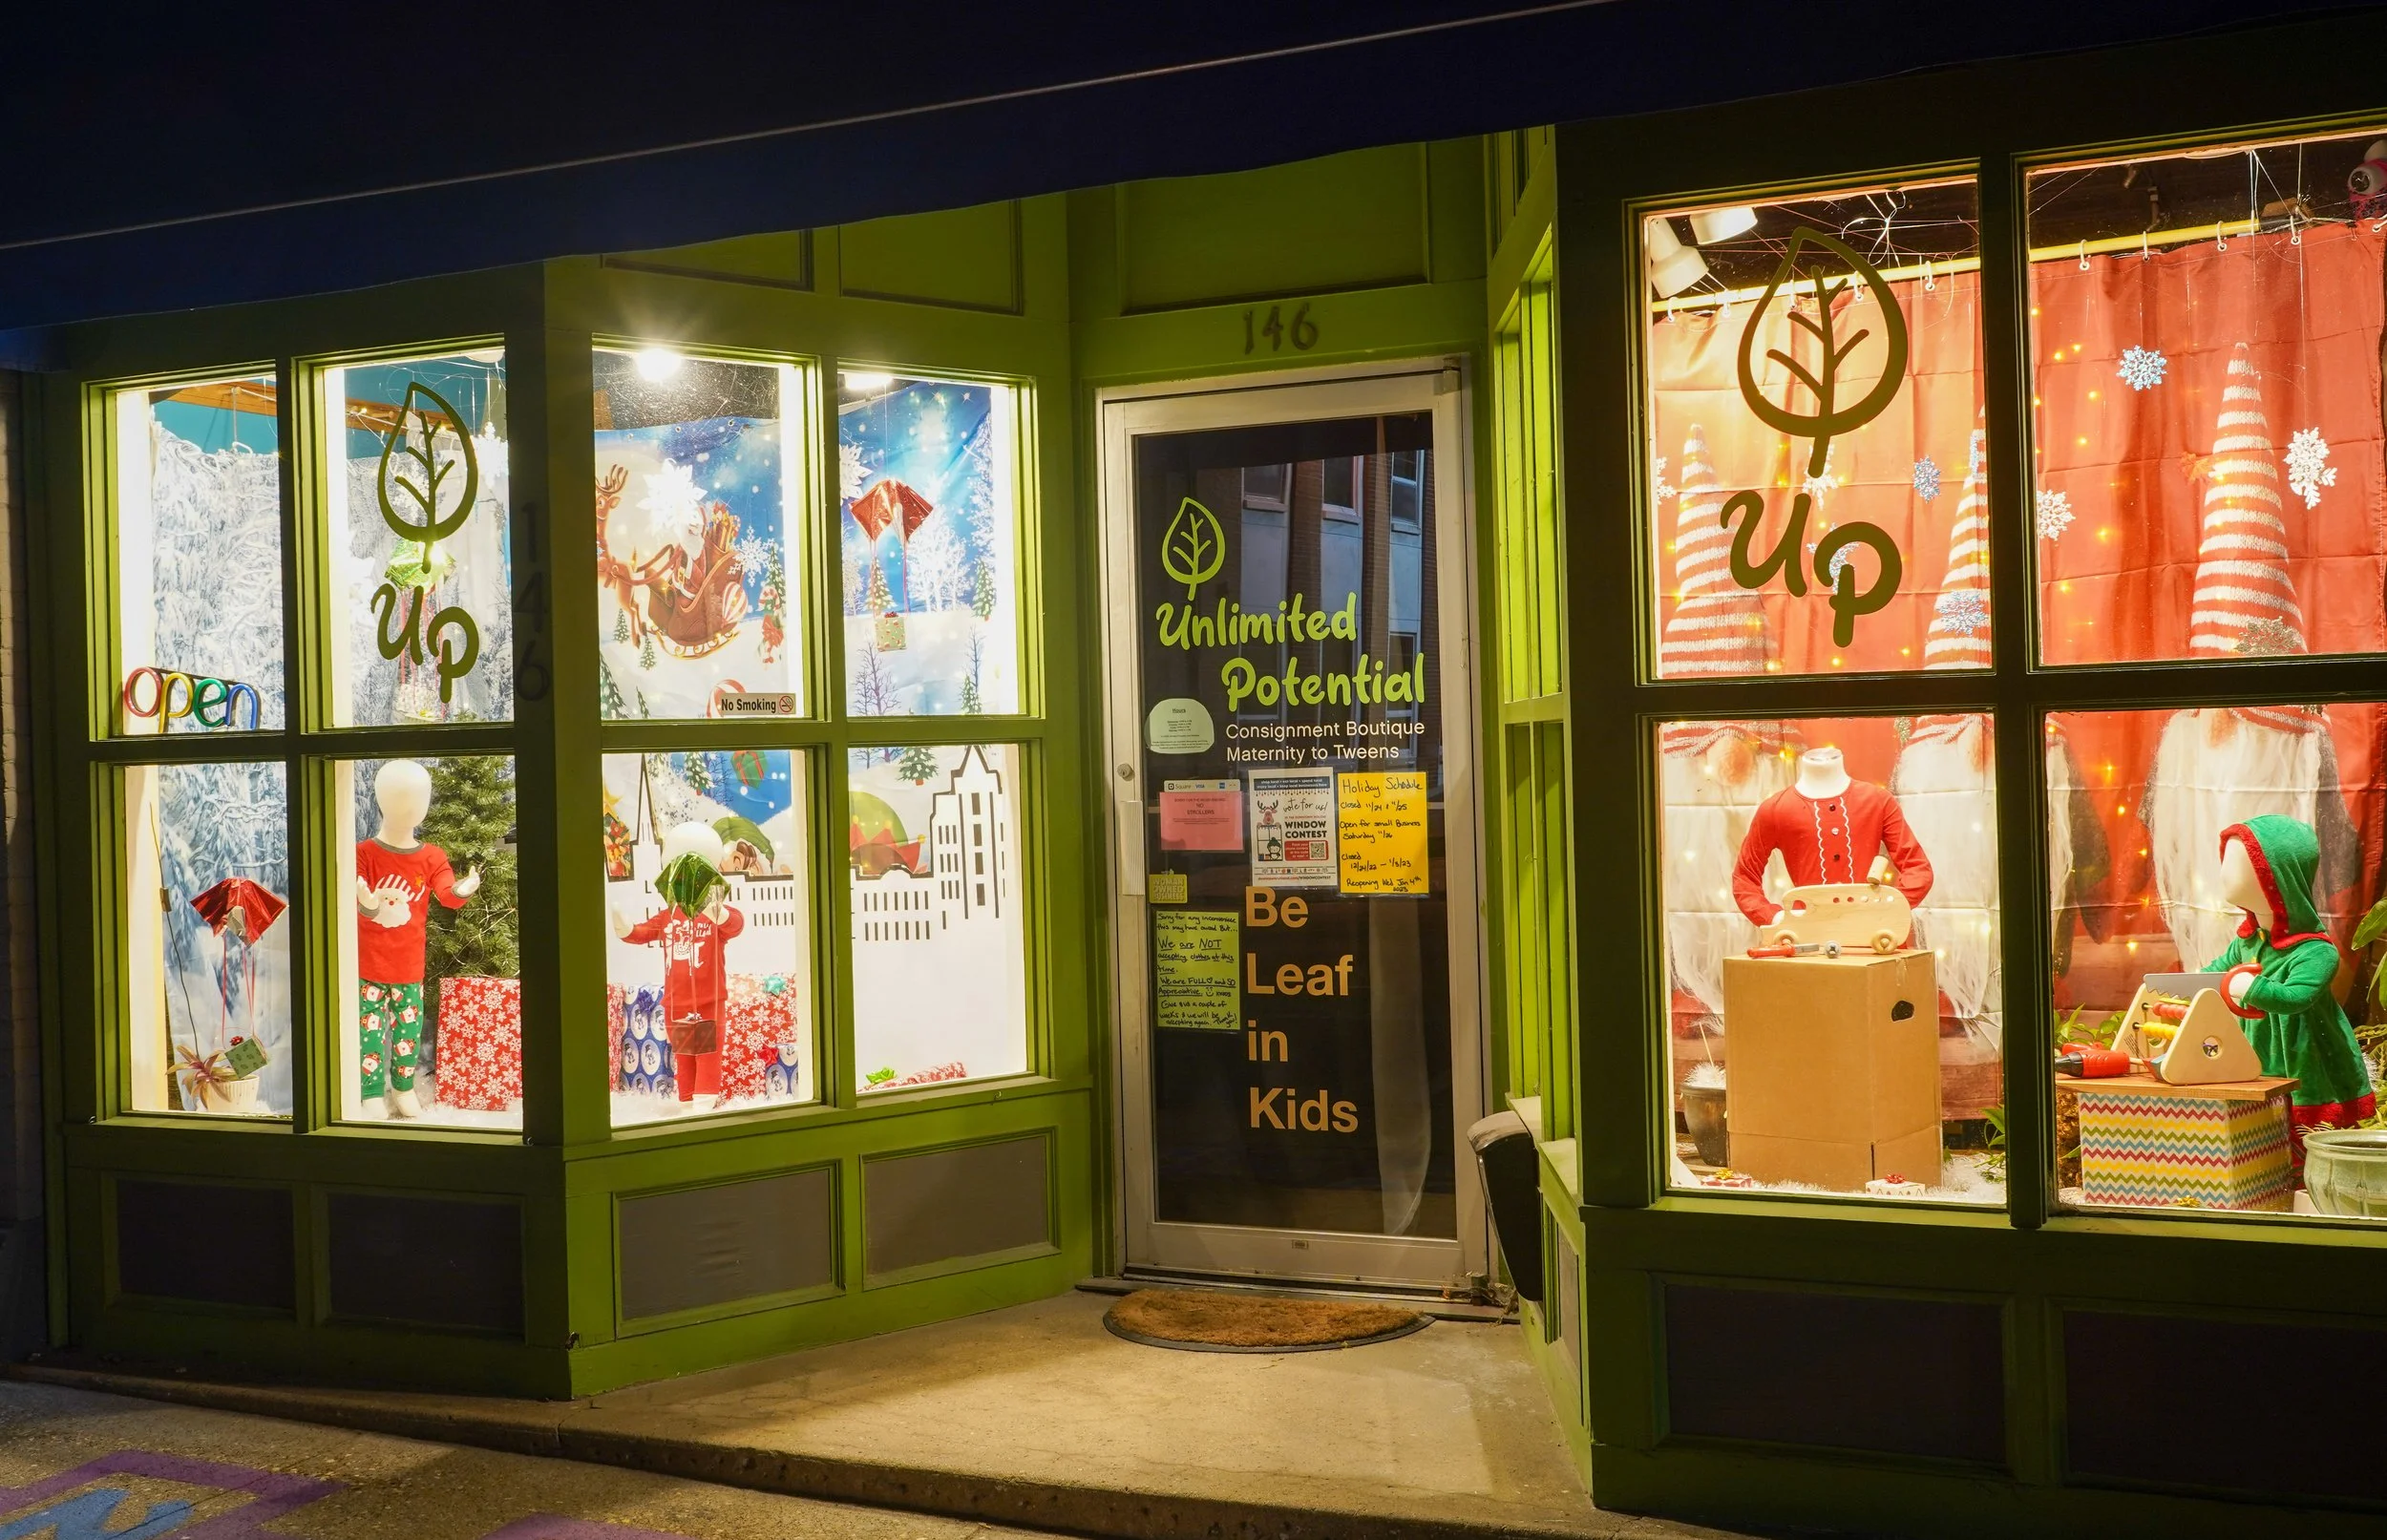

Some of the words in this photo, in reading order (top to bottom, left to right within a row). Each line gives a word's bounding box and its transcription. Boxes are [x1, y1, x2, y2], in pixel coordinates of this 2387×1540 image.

[1243, 303, 1319, 355] 146
[1155, 591, 1357, 650] Unlimited
[1221, 652, 1425, 712] Potential
[123, 667, 260, 733] open
[722, 699, 734, 710] No
[737, 699, 776, 713] Smoking
[1226, 723, 1340, 742] Consignment
[1346, 720, 1426, 739] Boutique
[1227, 746, 1305, 765] Maternity
[1312, 747, 1328, 760] to
[1334, 744, 1400, 760] Tweens
[1342, 779, 1381, 798] Holiday
[1283, 797, 1299, 812] vote
[1300, 797, 1314, 812] for
[1341, 799, 1361, 810] Closed
[1284, 820, 1326, 830] WINDOW
[1340, 820, 1358, 831] Open
[1360, 818, 1370, 827] for
[1285, 830, 1327, 839] CONTEST
[1342, 831, 1376, 843] Saturday
[1341, 852, 1361, 860] Closed
[1346, 877, 1379, 890] Reopening
[1246, 886, 1309, 928] Be
[1158, 913, 1174, 923] Sorry
[1188, 916, 1201, 924] any
[1158, 936, 1175, 949] We
[1199, 939, 1221, 949] NOT
[1247, 953, 1354, 996] Leaf
[1248, 1020, 1289, 1062] in
[1250, 1086, 1359, 1133] Kids
